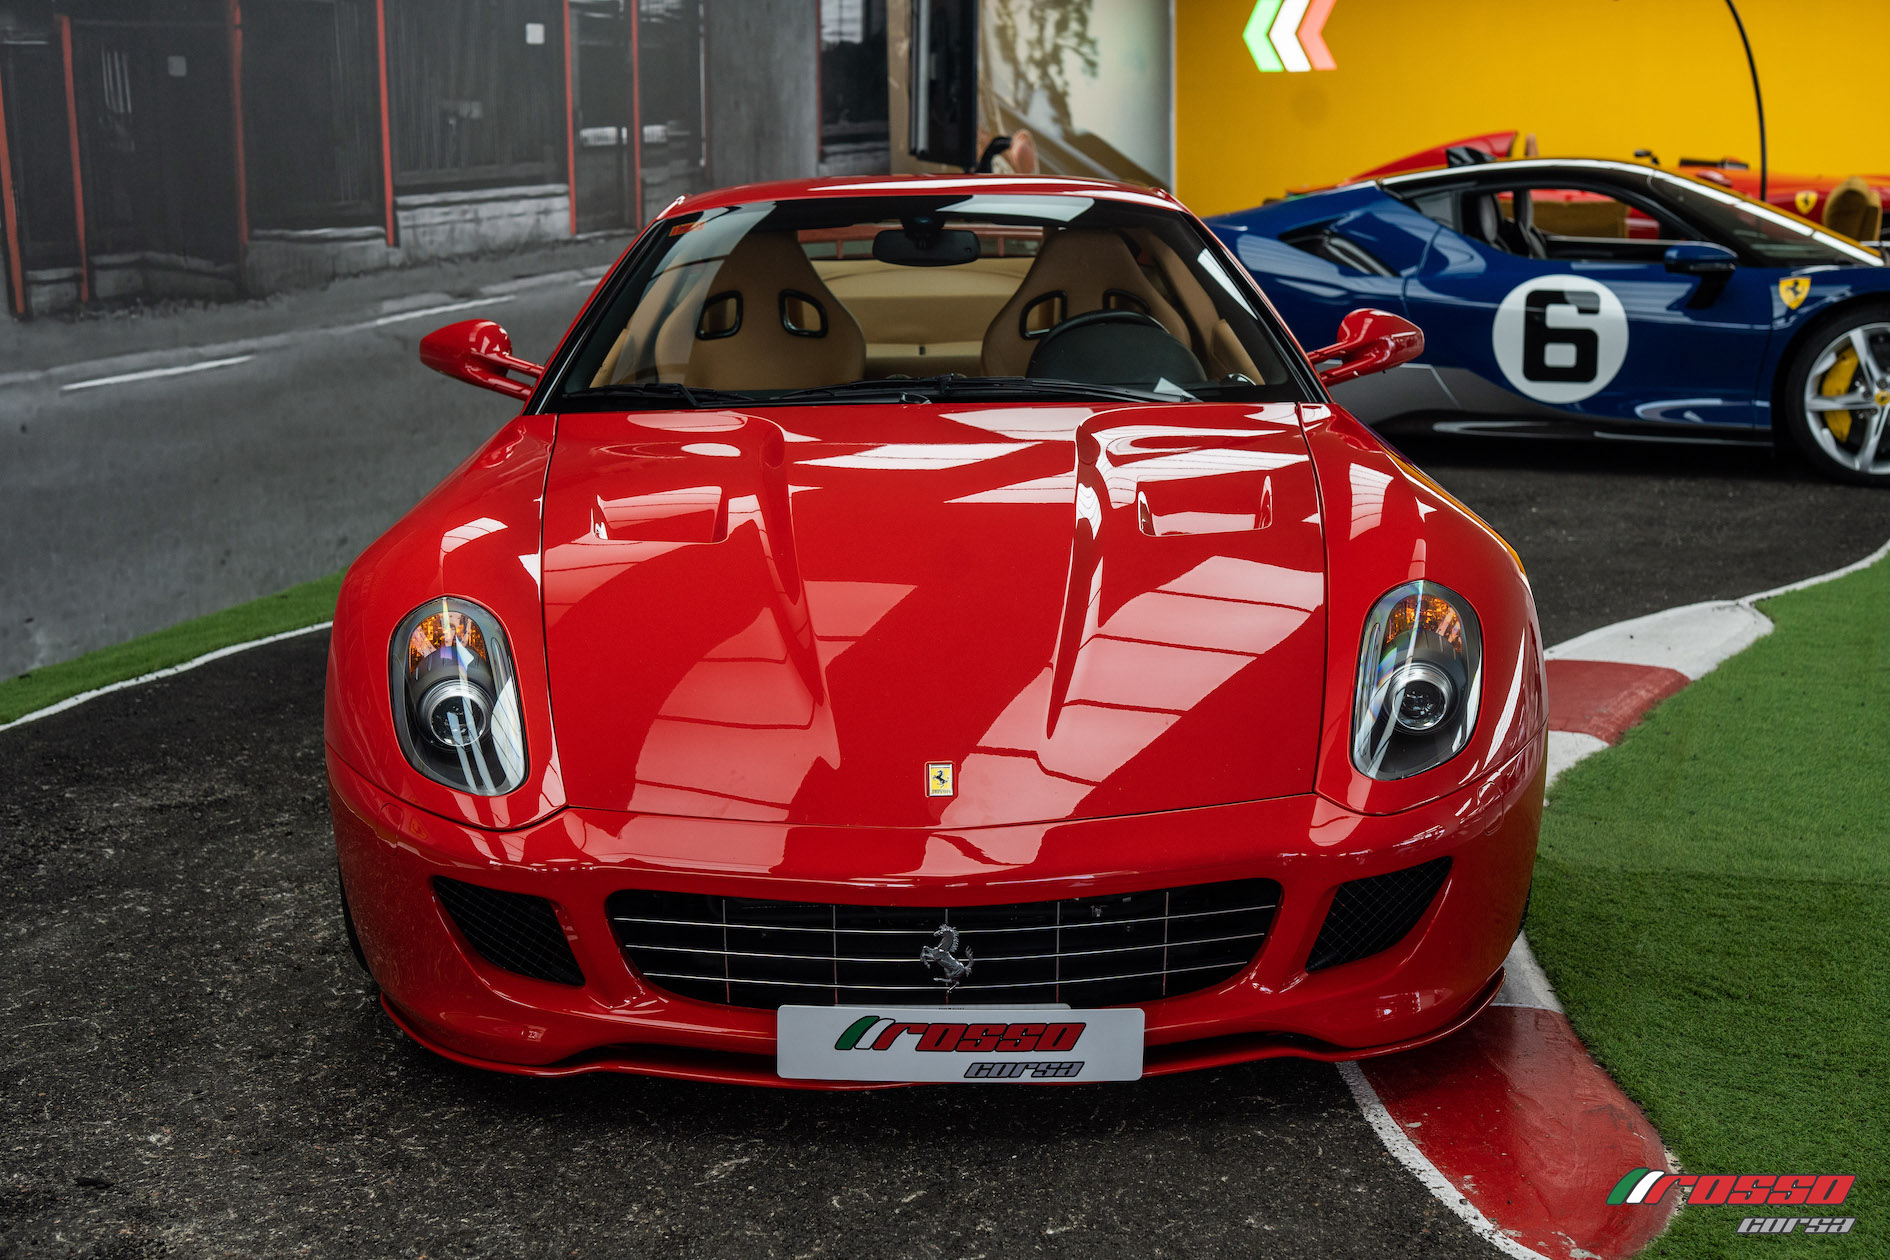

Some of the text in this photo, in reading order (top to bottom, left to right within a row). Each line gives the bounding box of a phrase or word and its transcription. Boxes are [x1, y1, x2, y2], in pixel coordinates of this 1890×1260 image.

[1523, 289, 1601, 383] 6
[872, 1022, 1087, 1053] rosso
[963, 1061, 1086, 1078] corsa
